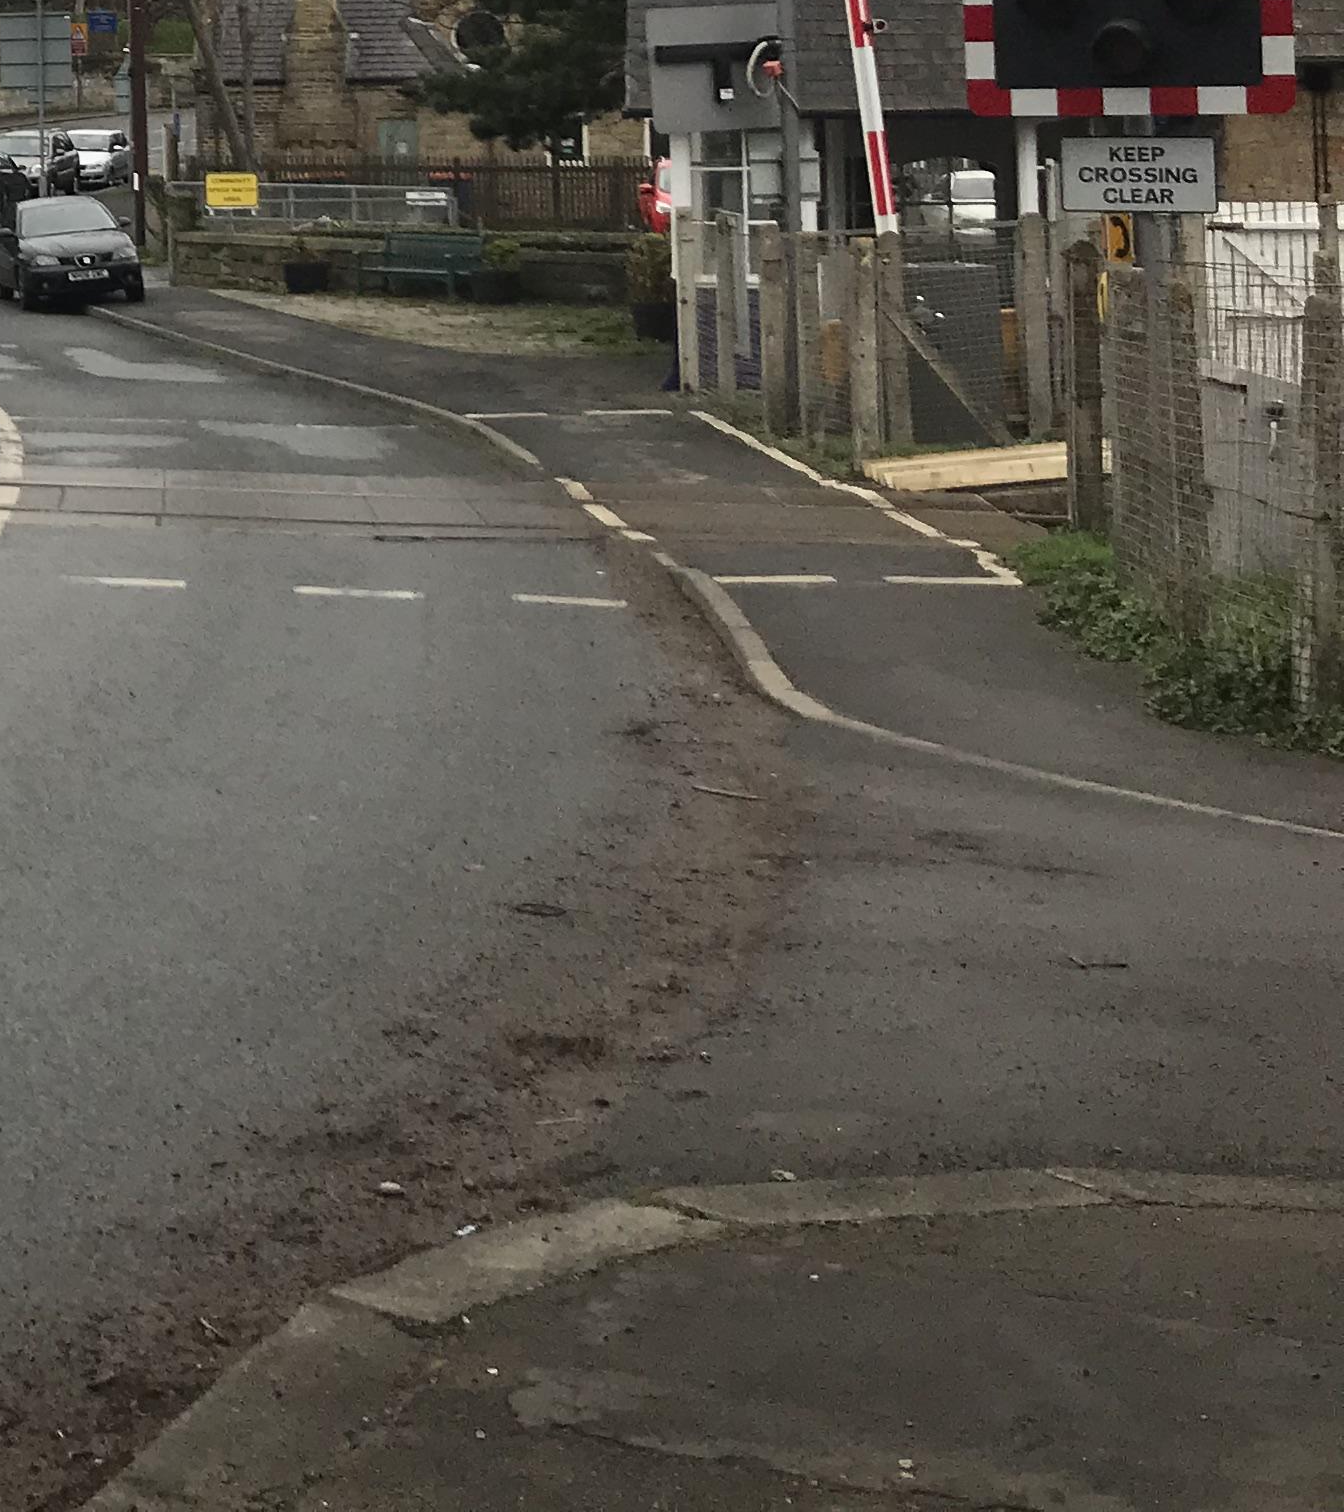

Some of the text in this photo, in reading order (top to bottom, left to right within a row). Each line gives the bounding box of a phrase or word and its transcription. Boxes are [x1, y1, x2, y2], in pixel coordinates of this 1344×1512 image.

[1108, 145, 1166, 163] KEEP
[1078, 166, 1199, 184] CROSSING
[1103, 187, 1175, 205] CLEAR
